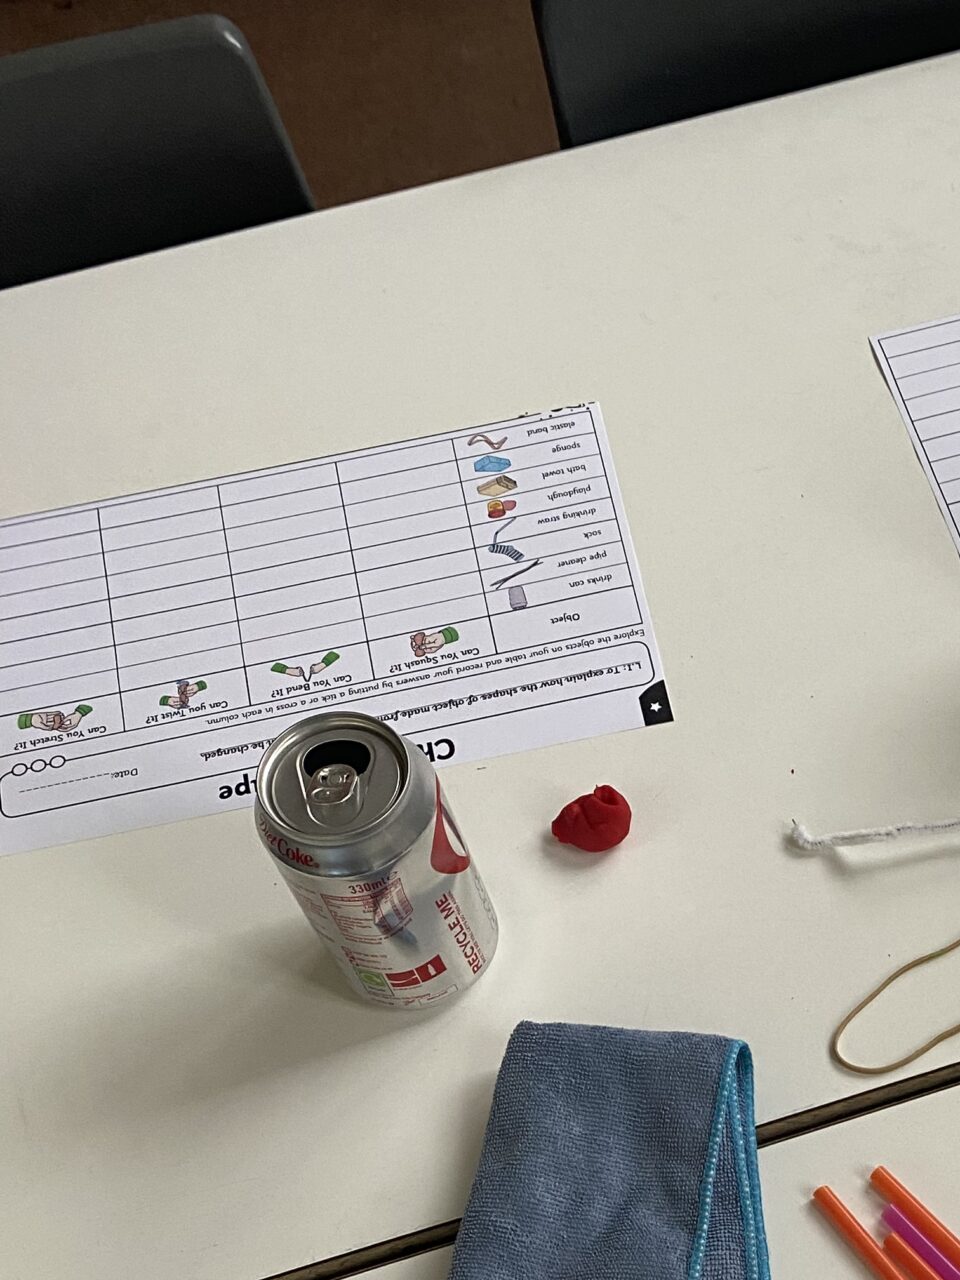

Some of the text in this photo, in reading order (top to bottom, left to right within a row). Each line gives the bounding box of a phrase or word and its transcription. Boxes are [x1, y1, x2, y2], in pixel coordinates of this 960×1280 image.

[549, 612, 581, 625] Object
[388, 647, 481, 674] Can You Squash It?
[270, 673, 353, 699] Can You Bend It?
[144, 699, 229, 725] Can you Twist It?
[13, 725, 108, 752] Can You Stretch It?
[277, 837, 315, 868] Coke
[434, 892, 457, 921] ME
[449, 916, 484, 976] RECYCLE
